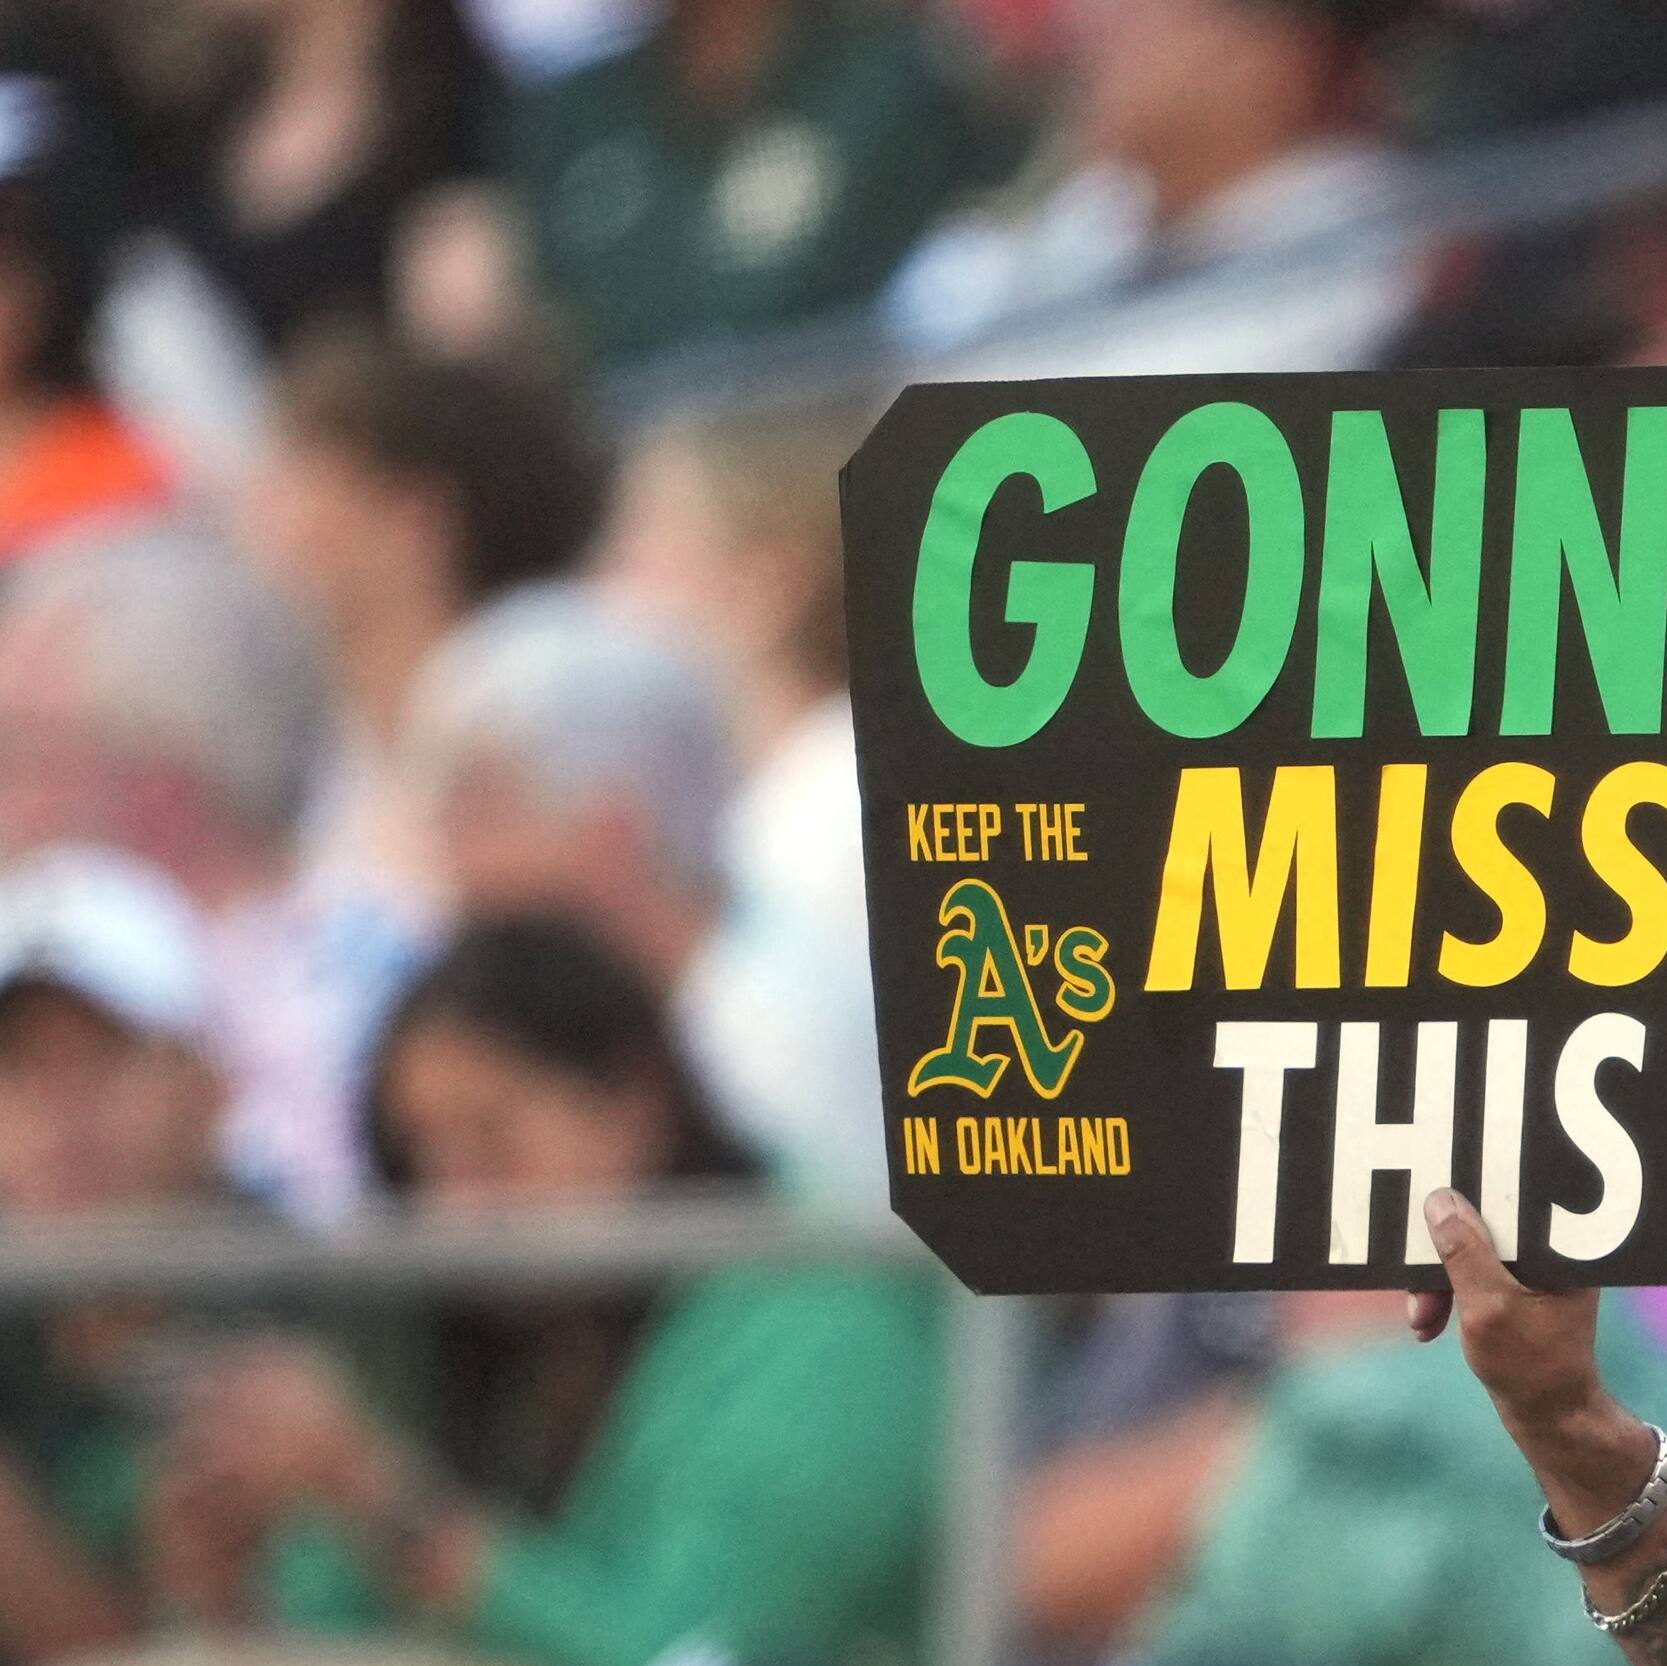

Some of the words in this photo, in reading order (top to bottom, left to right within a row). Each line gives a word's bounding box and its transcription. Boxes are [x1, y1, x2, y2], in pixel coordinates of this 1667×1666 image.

[907, 804, 1002, 862] KEEP
[1015, 803, 1089, 862] THE
[907, 879, 1116, 1100] A's
[903, 1117, 941, 1175] IN
[956, 1117, 1132, 1176] OAKLAND
[1213, 1012, 1647, 1266] THIS
